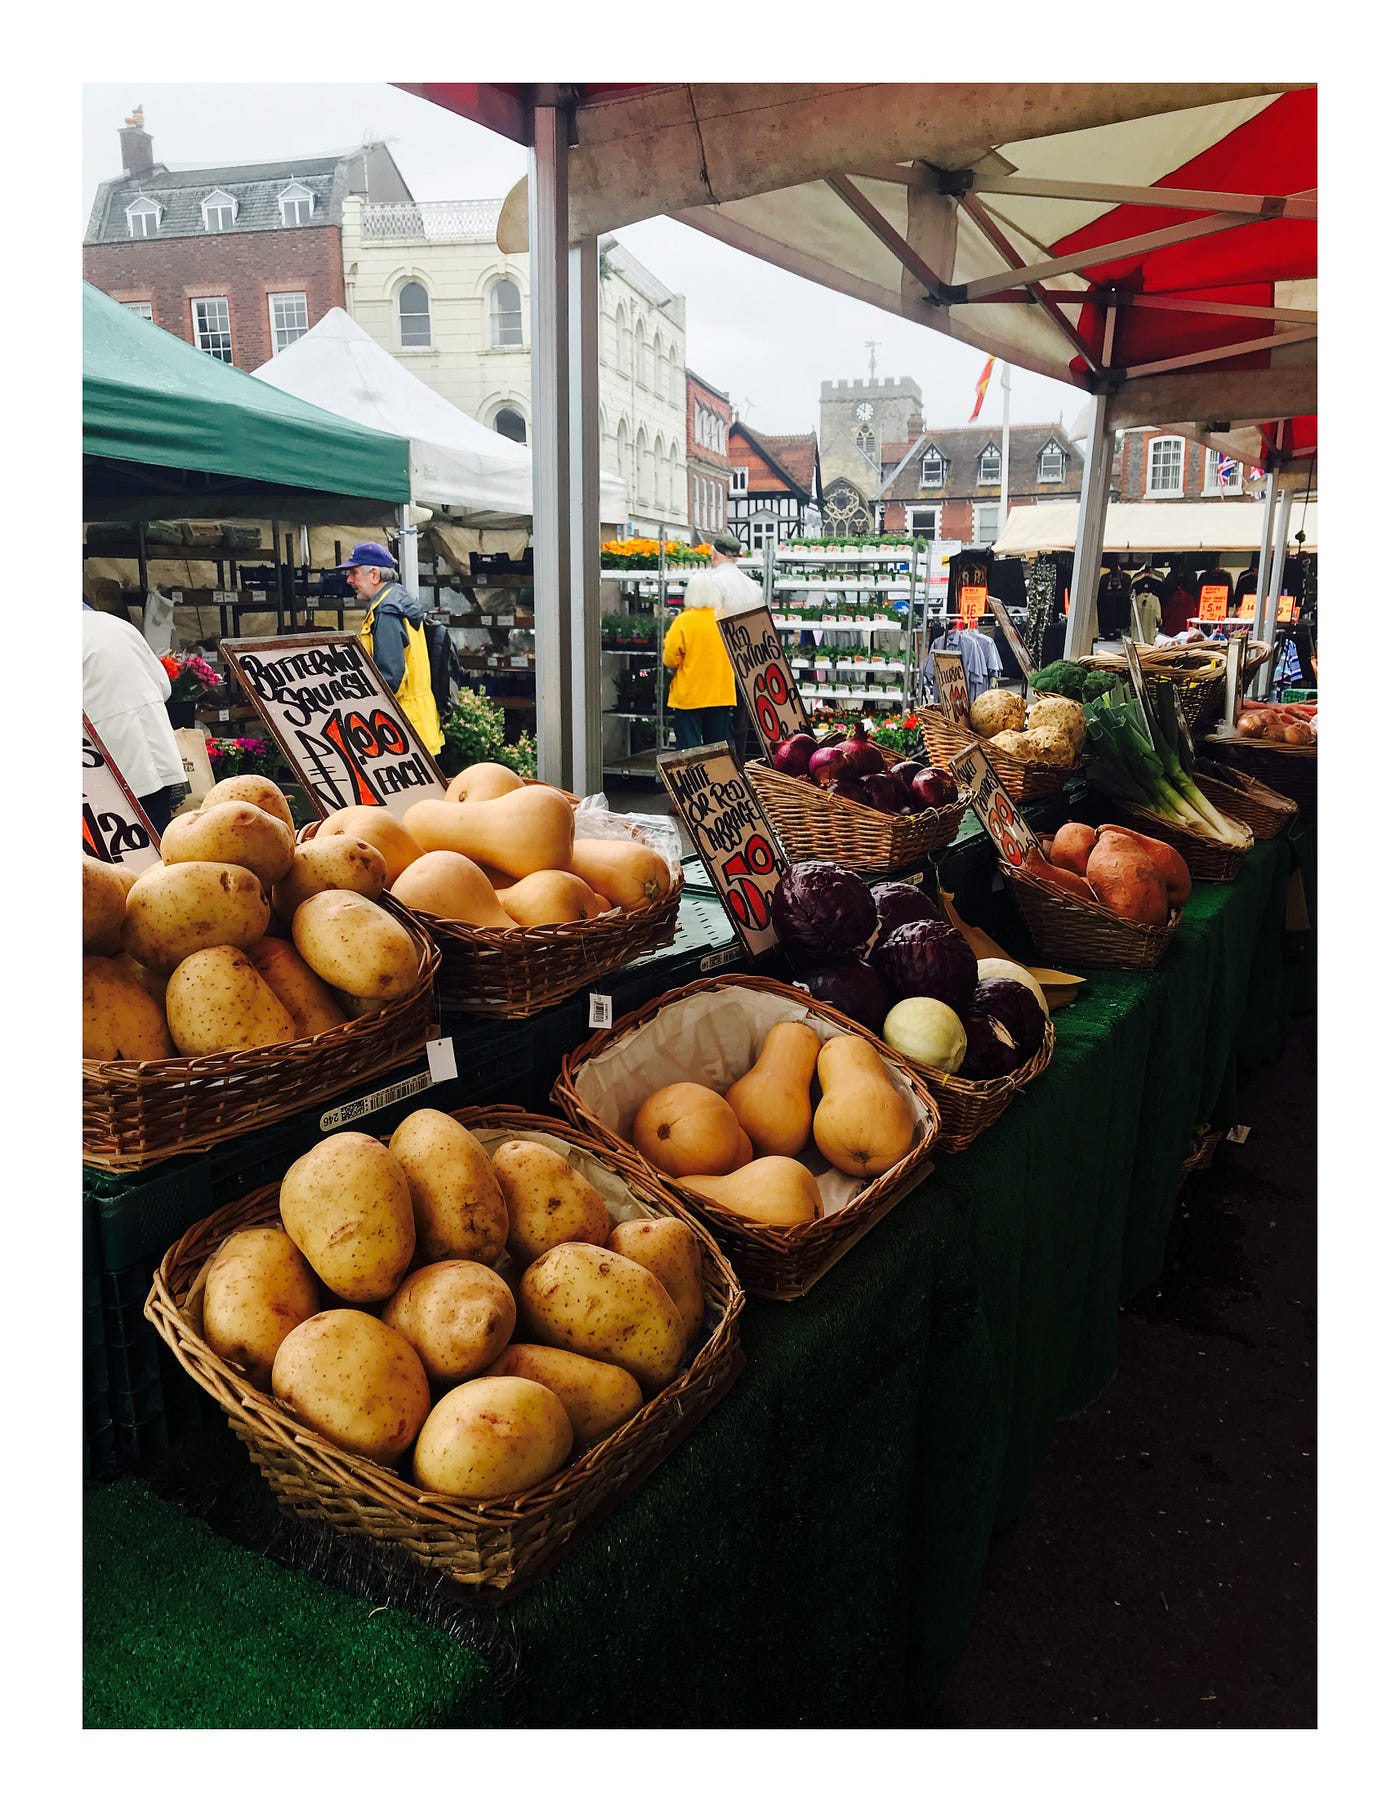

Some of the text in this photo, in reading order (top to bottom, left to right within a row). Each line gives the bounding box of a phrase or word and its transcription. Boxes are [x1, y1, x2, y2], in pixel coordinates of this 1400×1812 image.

[724, 622, 750, 652] RED
[736, 631, 781, 678] ONIONS
[239, 644, 363, 701] BUTTERNUT
[278, 670, 378, 726] SQUASH
[373, 753, 434, 795] EACH
[669, 763, 714, 804] WHITE
[957, 759, 977, 783] SWEET
[688, 780, 745, 823] OR RED
[694, 800, 760, 861] CABBAGE
[323, 1113, 338, 1126] 246
